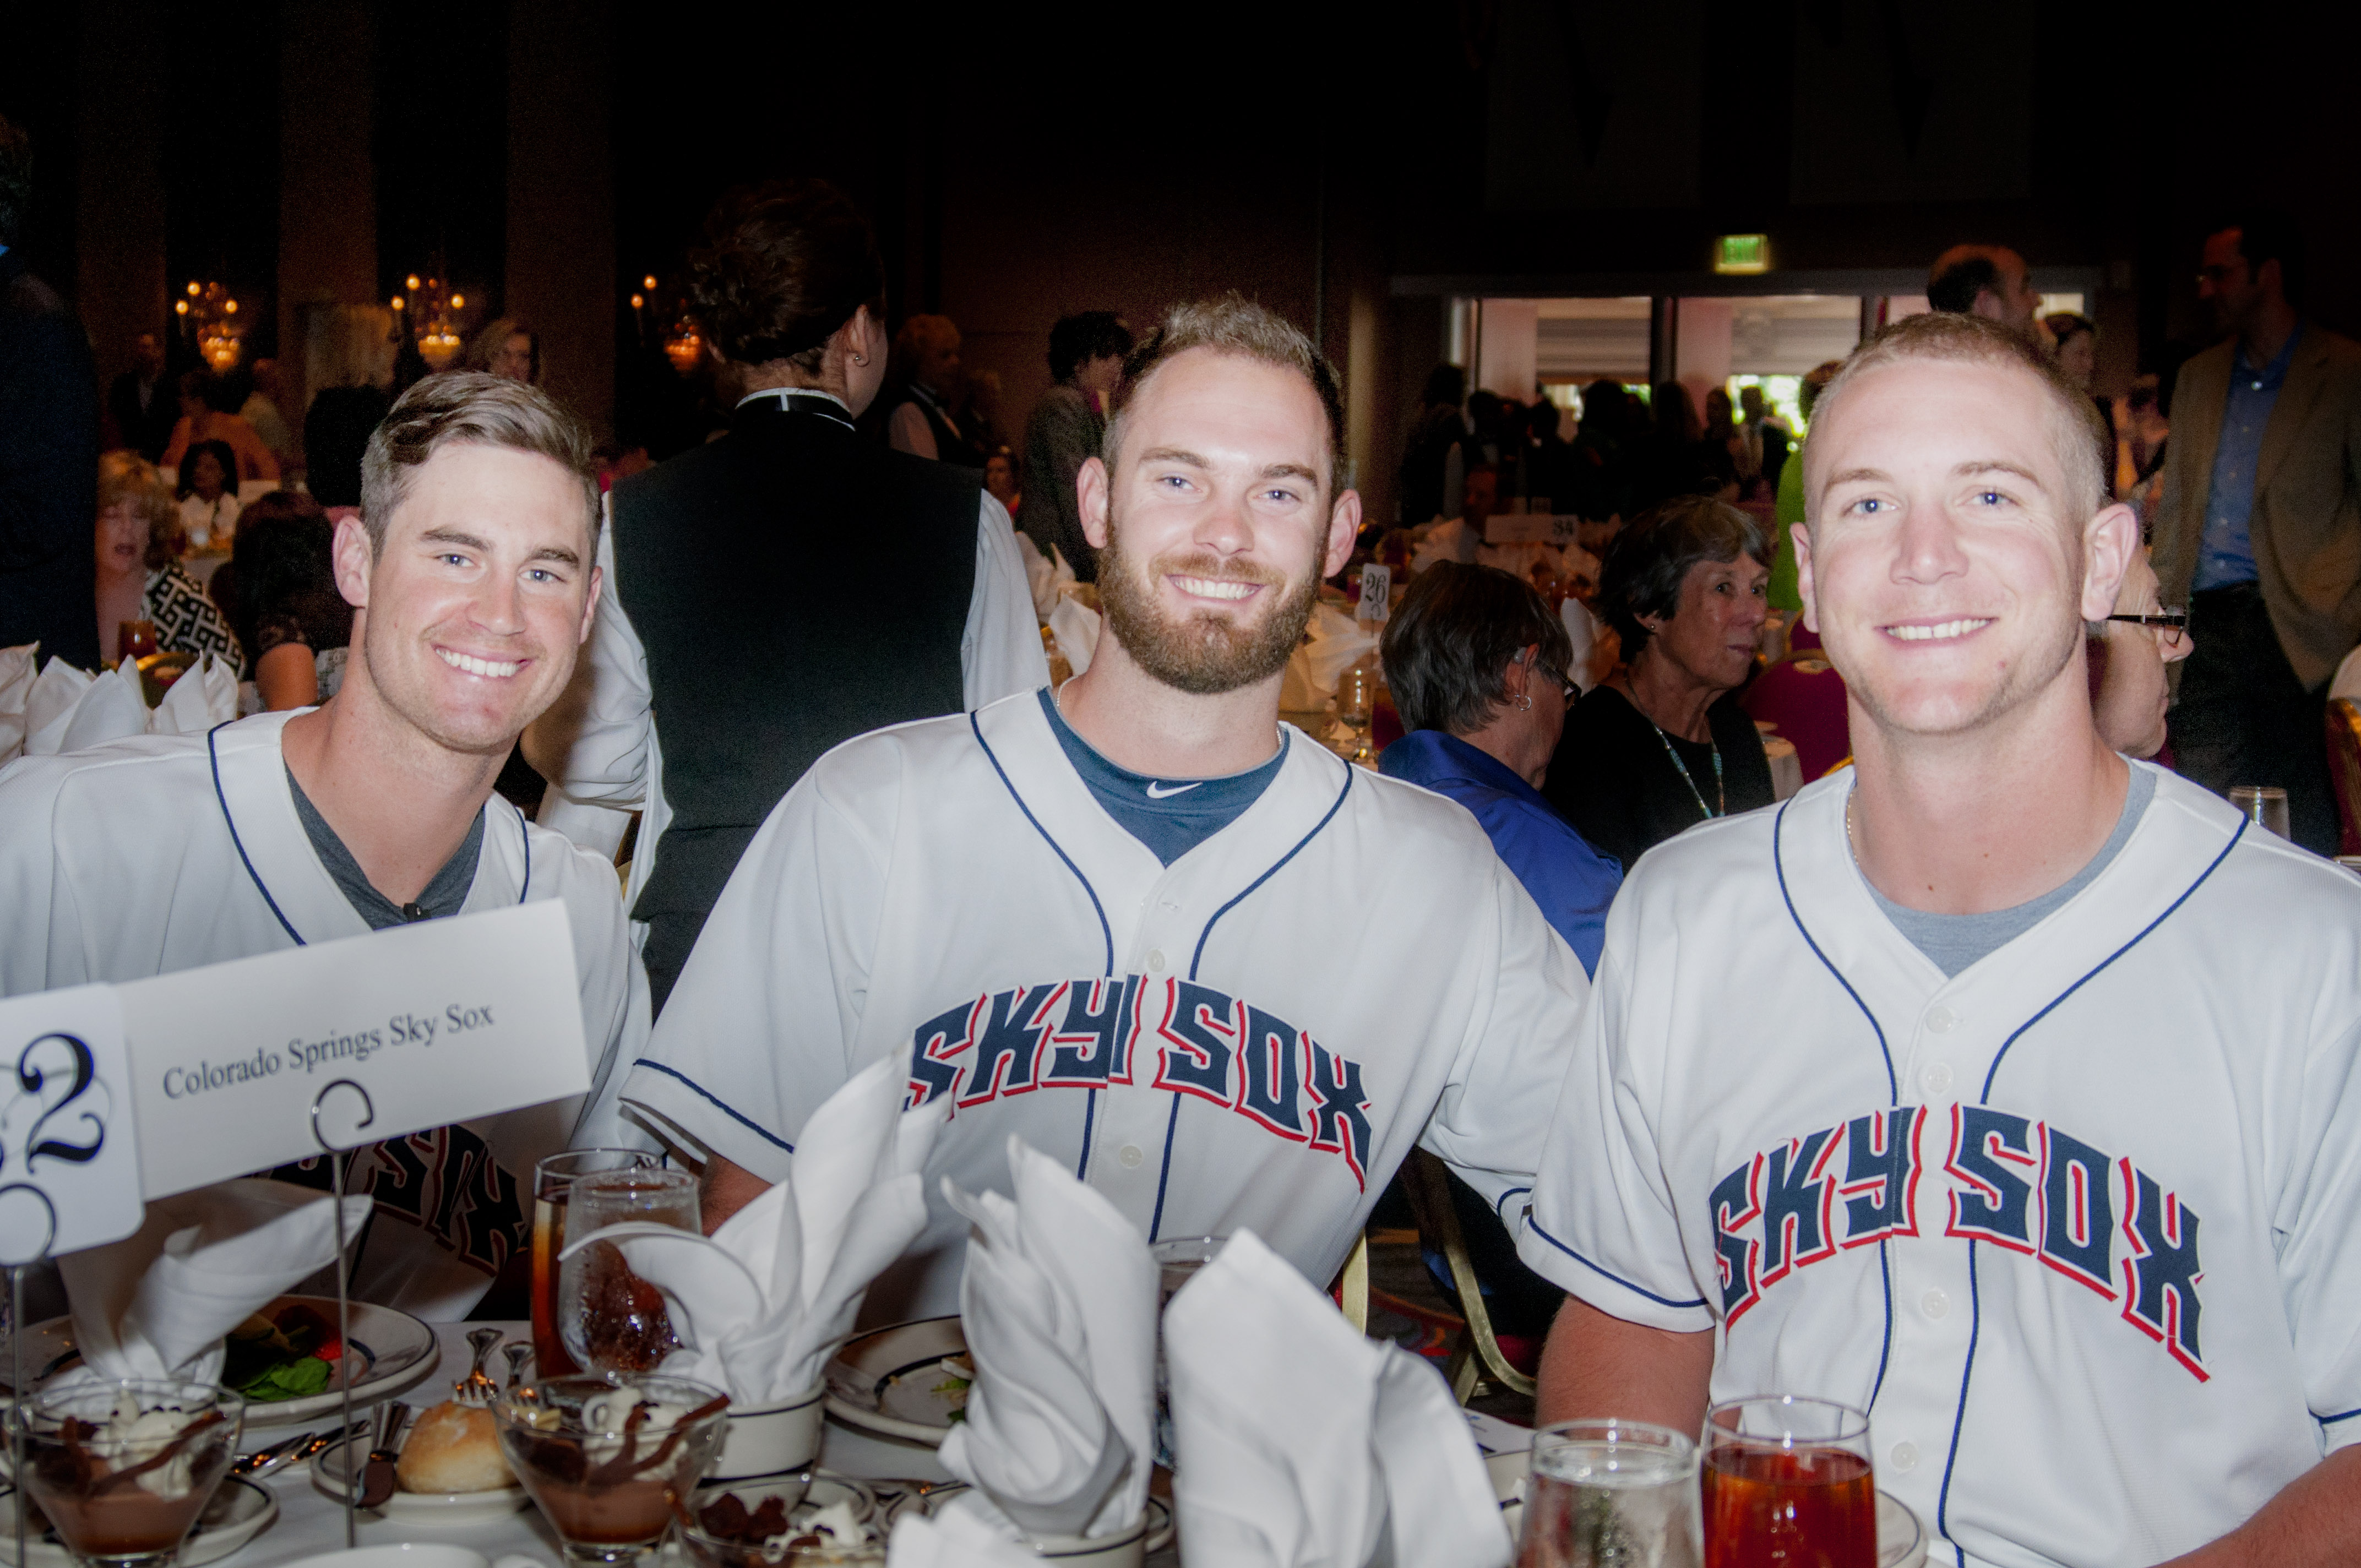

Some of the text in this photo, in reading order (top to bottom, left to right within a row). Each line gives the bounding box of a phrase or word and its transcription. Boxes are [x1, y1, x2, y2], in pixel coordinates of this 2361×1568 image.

[1366, 573, 1386, 604] 26
[0, 1033, 104, 1173] 2
[162, 1004, 494, 1099] Colorado Springs Sky Sox
[902, 974, 1372, 1194] SKY SOX
[1709, 1102, 2210, 1383] SKY SOX
